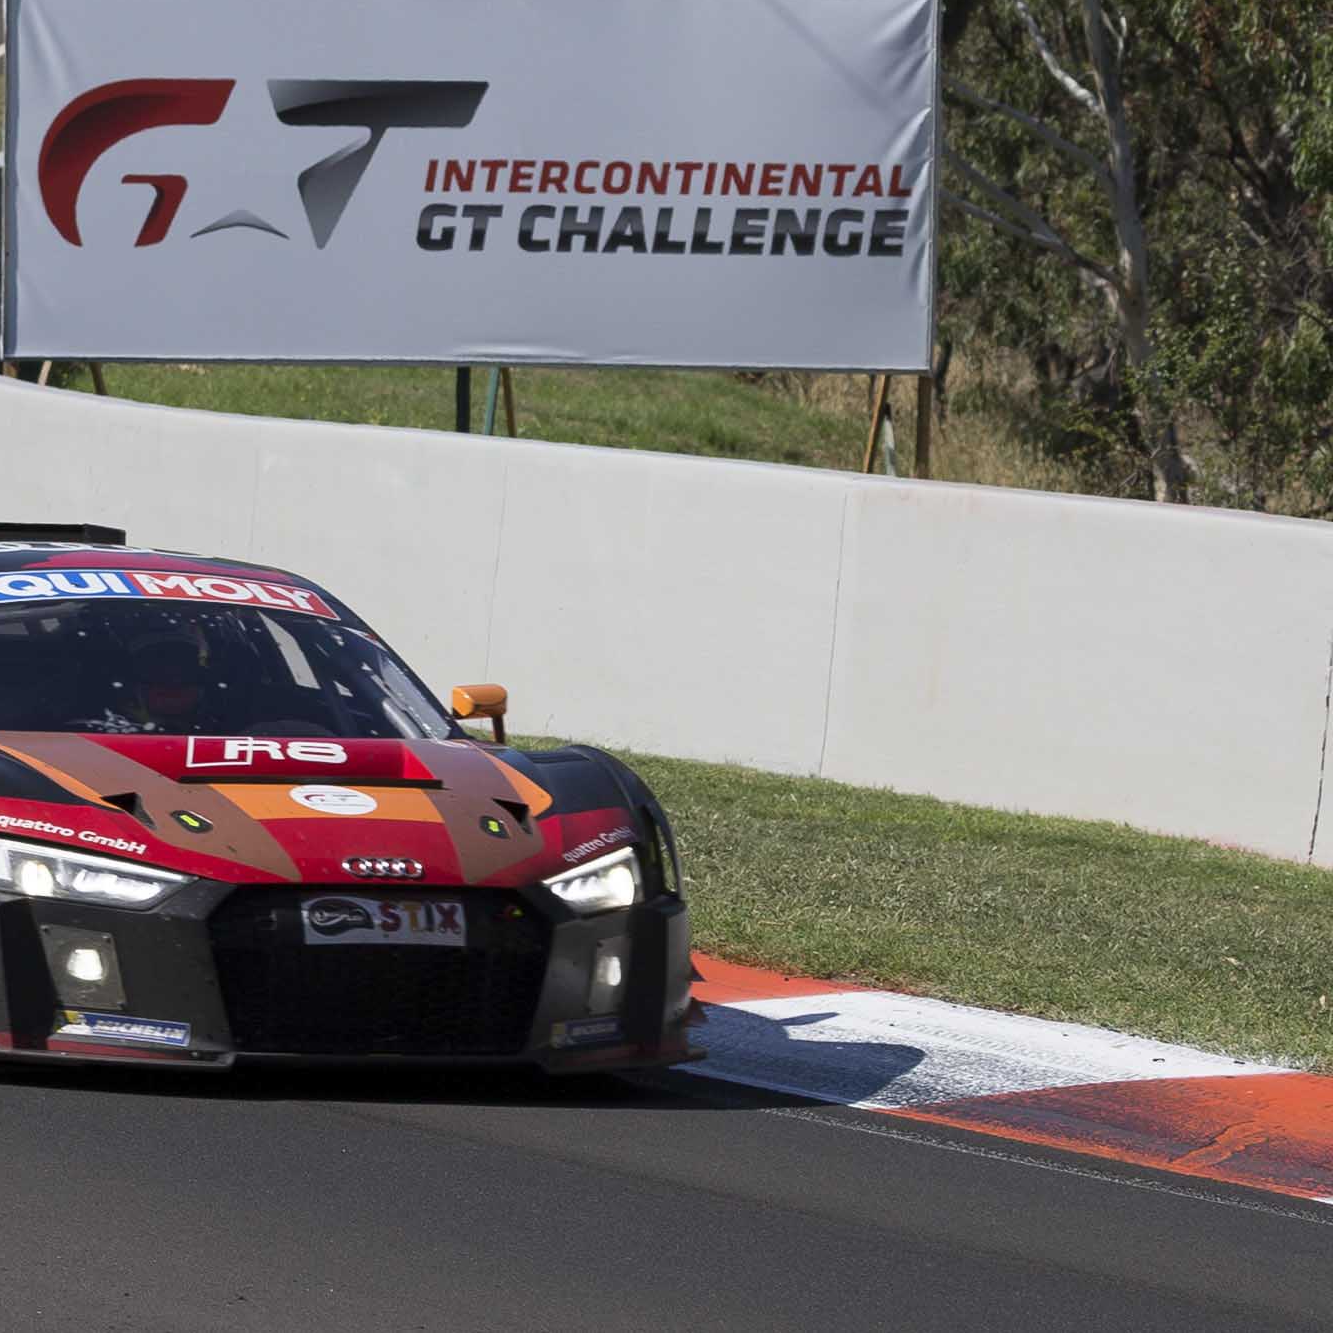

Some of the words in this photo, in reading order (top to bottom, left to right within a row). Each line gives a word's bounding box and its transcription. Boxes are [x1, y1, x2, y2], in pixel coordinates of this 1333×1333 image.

[424, 159, 912, 198] INTERCONTINENTAL
[416, 203, 503, 251] GT
[518, 204, 910, 257] CHALLENGE
[136, 573, 321, 612] MOLY
[224, 739, 348, 764] R8
[77, 830, 147, 855] GmbH
[563, 835, 605, 863] quattro
[379, 901, 461, 935] STIX
